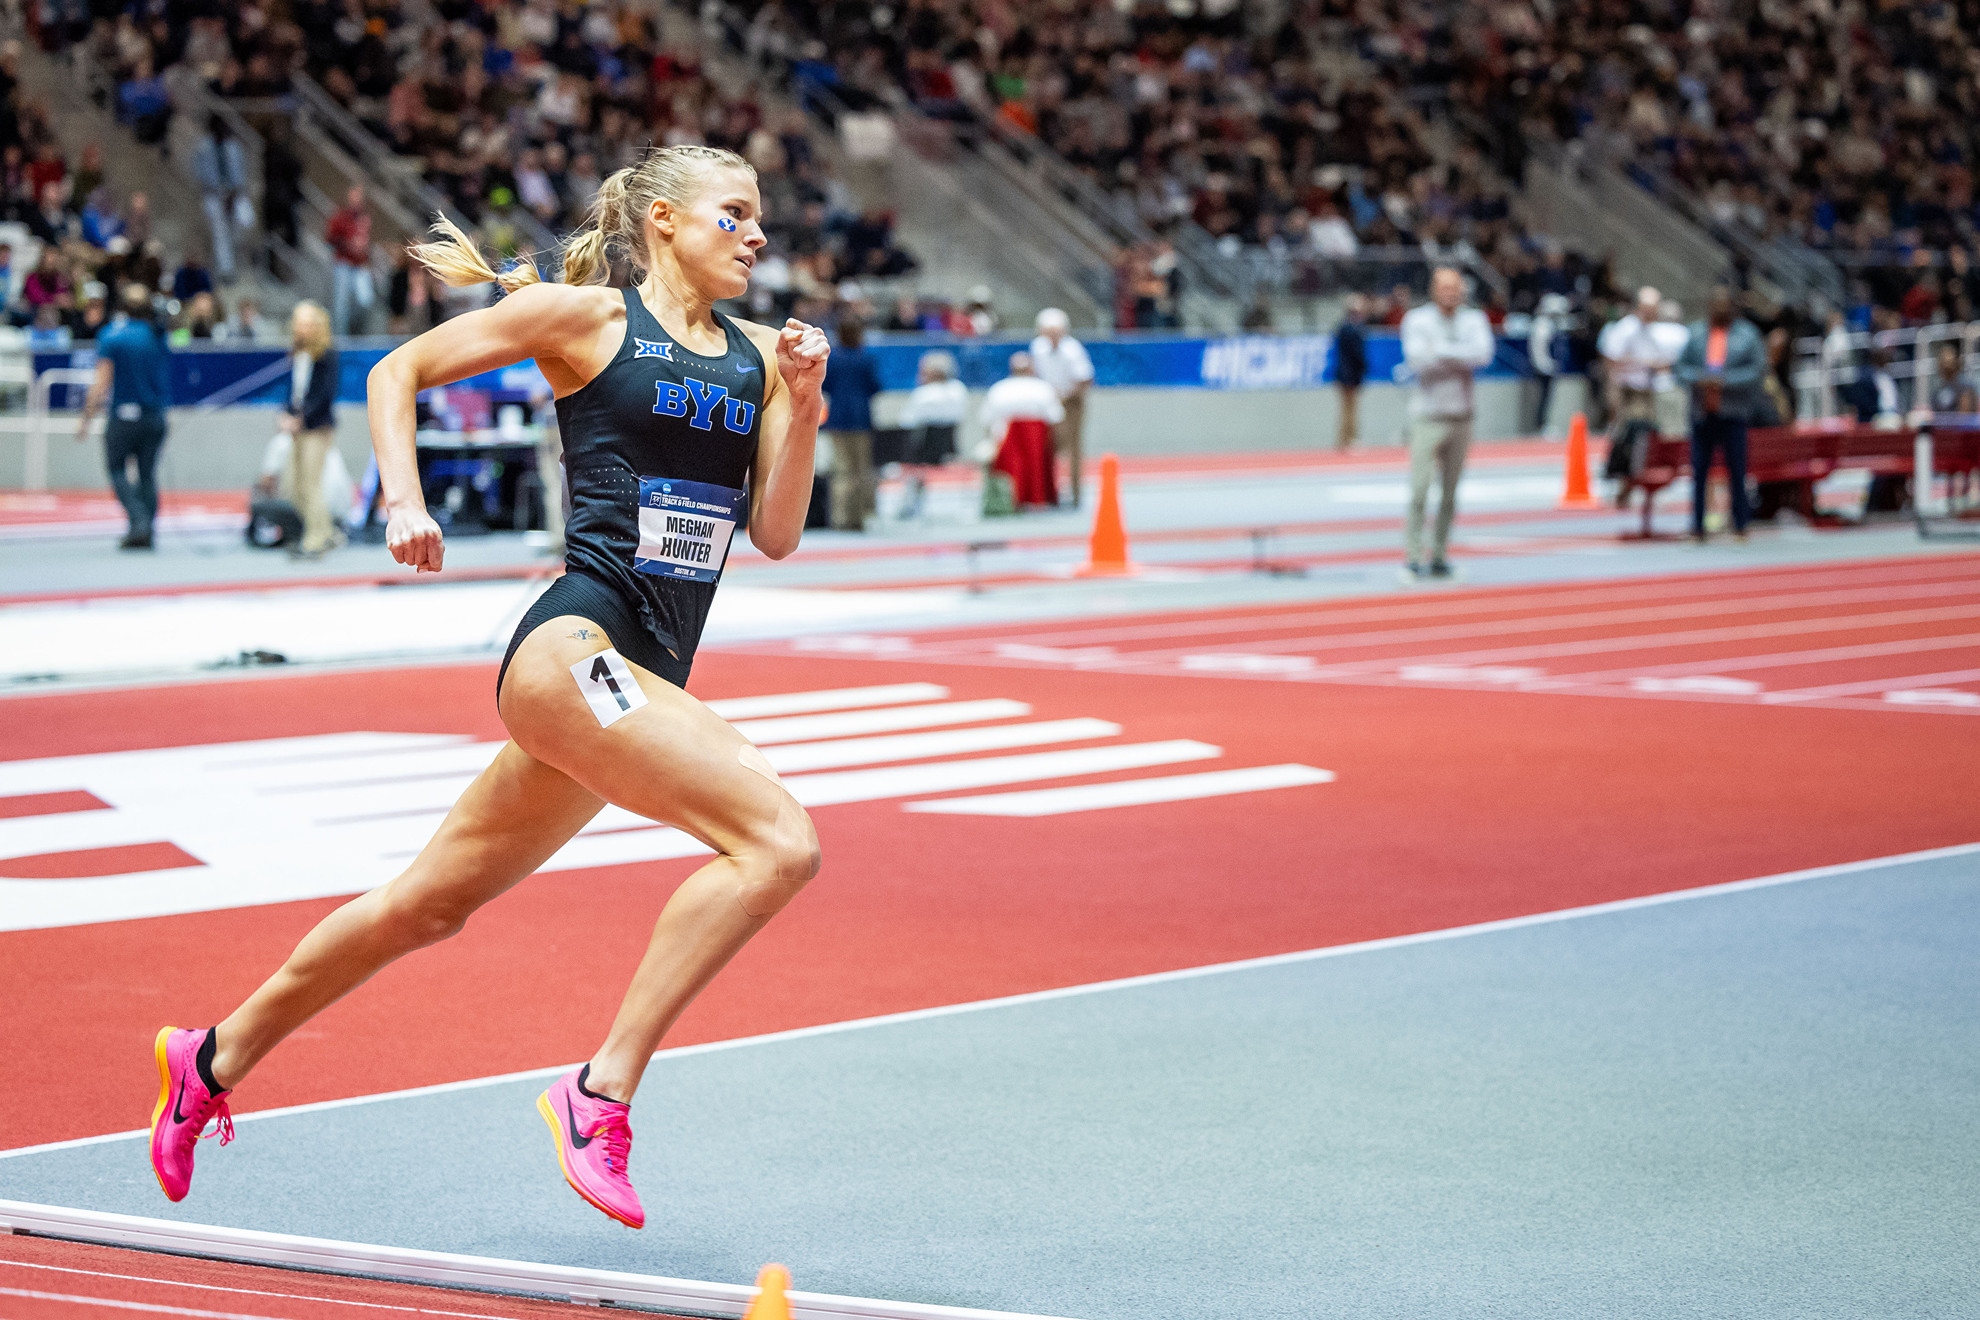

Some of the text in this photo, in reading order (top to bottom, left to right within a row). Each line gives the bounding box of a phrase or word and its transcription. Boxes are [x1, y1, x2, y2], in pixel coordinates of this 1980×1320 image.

[636, 340, 671, 359] XII
[652, 376, 755, 435] BYU
[662, 497, 678, 505] TRACK
[682, 500, 696, 508] FIELD
[696, 502, 731, 514] CHAMPIONSHIPS
[666, 516, 715, 538] MEGHAN
[660, 536, 712, 564] HUNTER
[589, 655, 631, 712] 1
